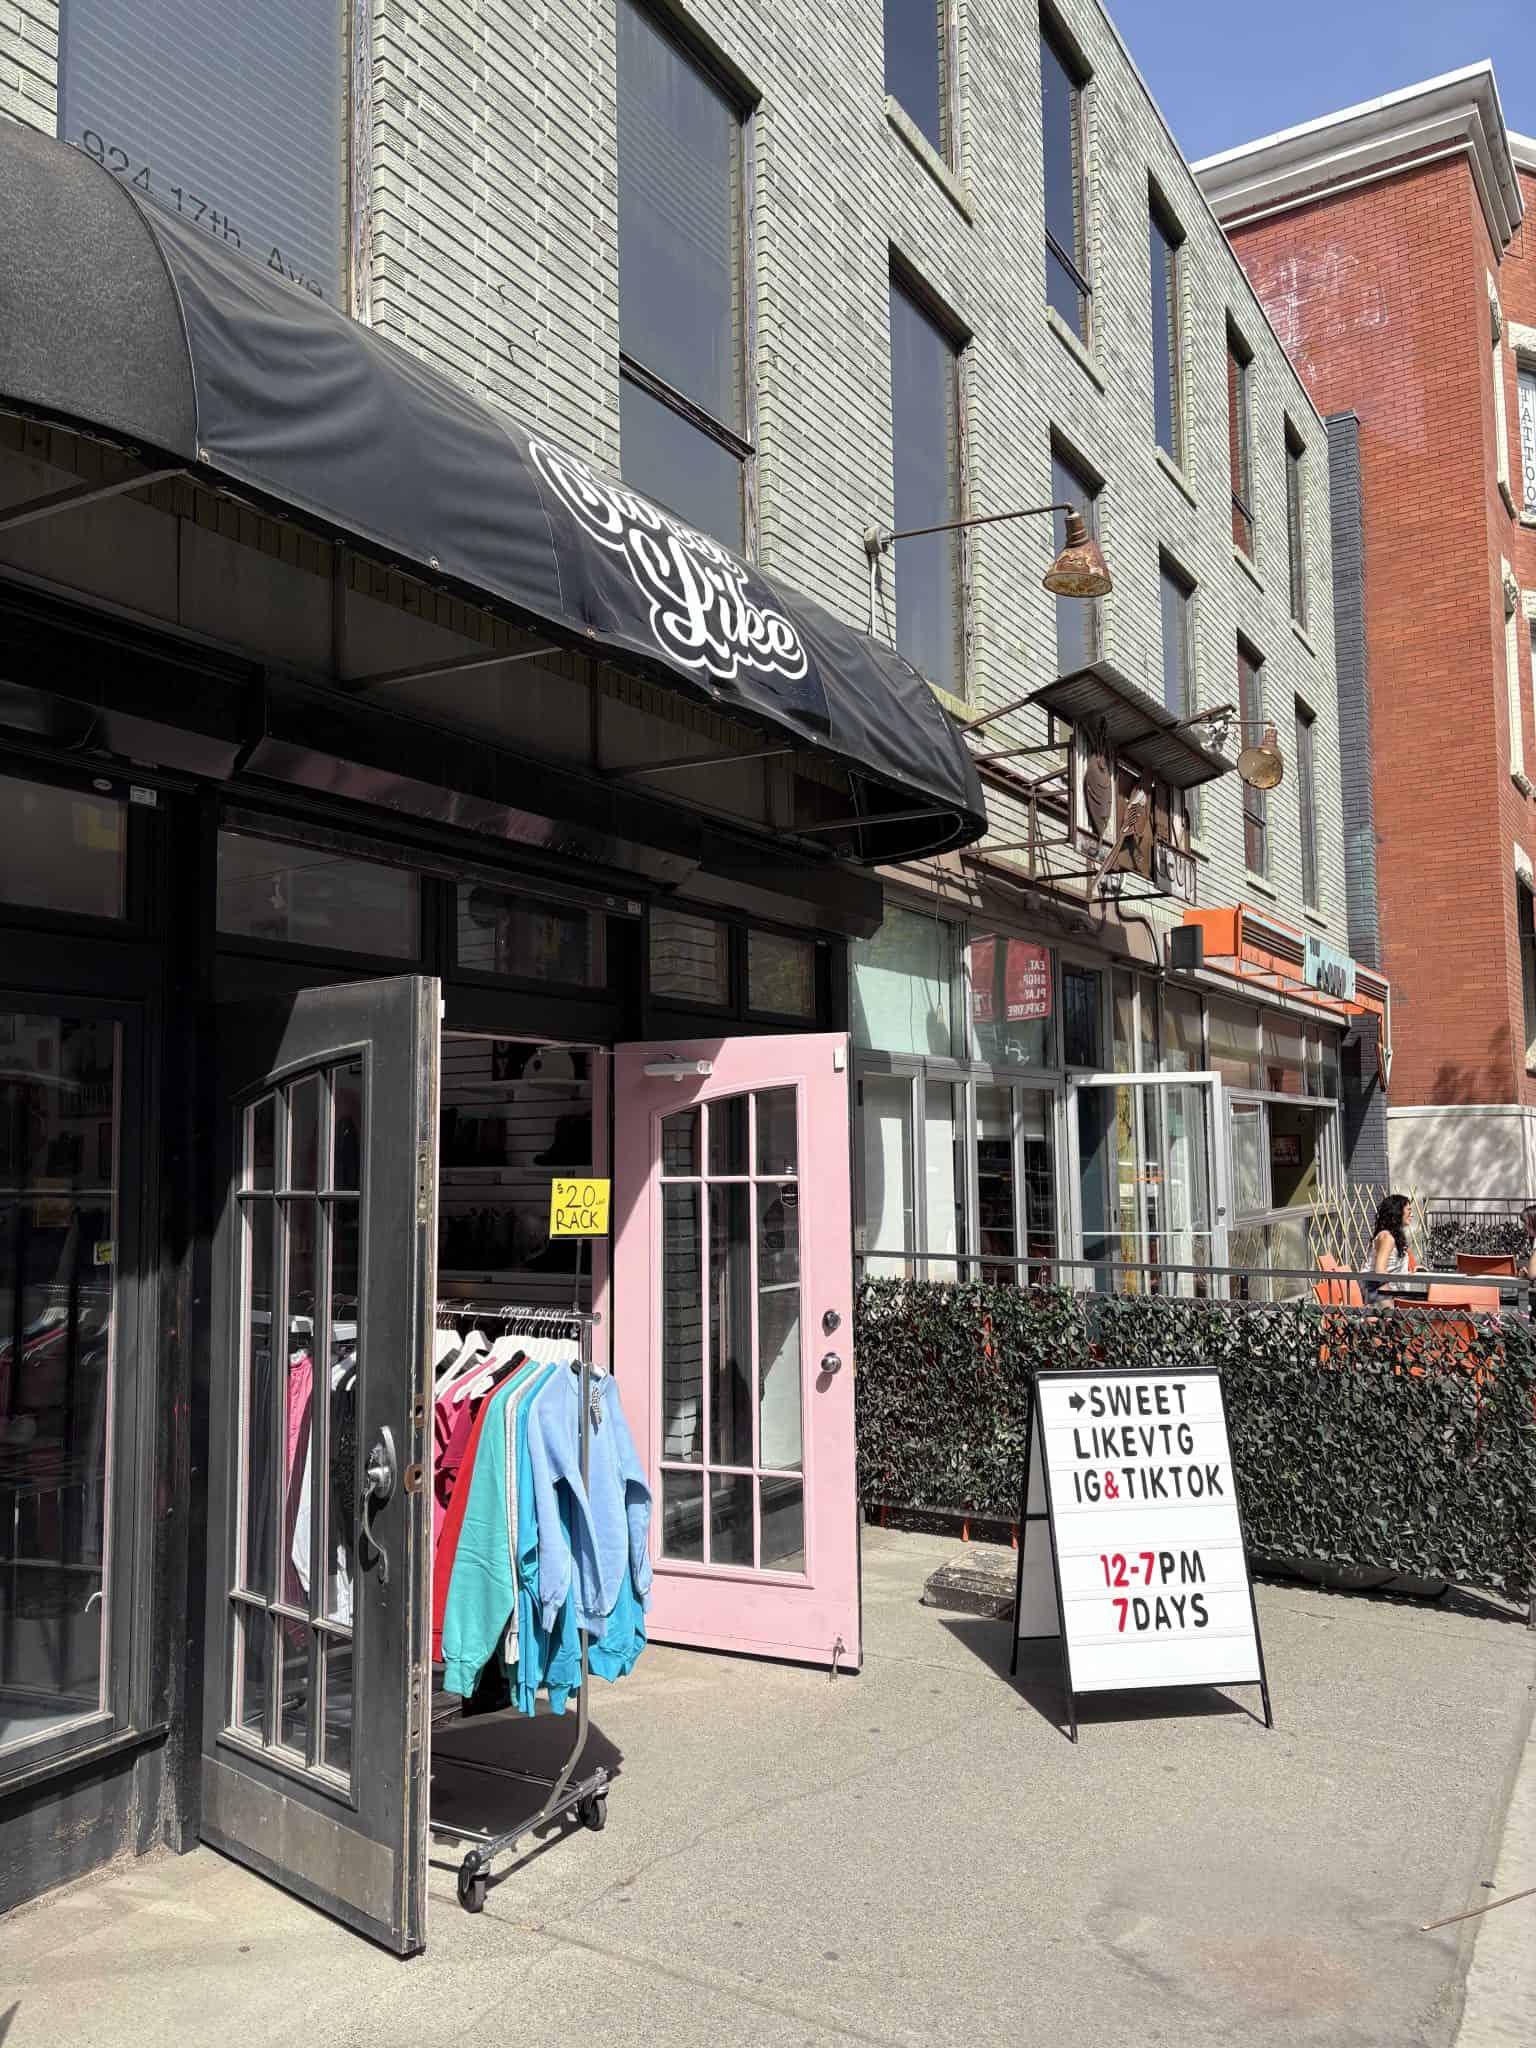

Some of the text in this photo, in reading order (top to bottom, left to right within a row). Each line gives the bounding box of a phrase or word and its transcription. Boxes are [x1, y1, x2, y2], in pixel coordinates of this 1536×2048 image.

[170, 187, 241, 249] 17th
[1521, 388, 1536, 501] TATTOO
[628, 527, 803, 662] Like
[556, 1208, 600, 1231] RACK
[1090, 1384, 1186, 1418] SWEET
[1073, 1423, 1194, 1459] LIKEVTG
